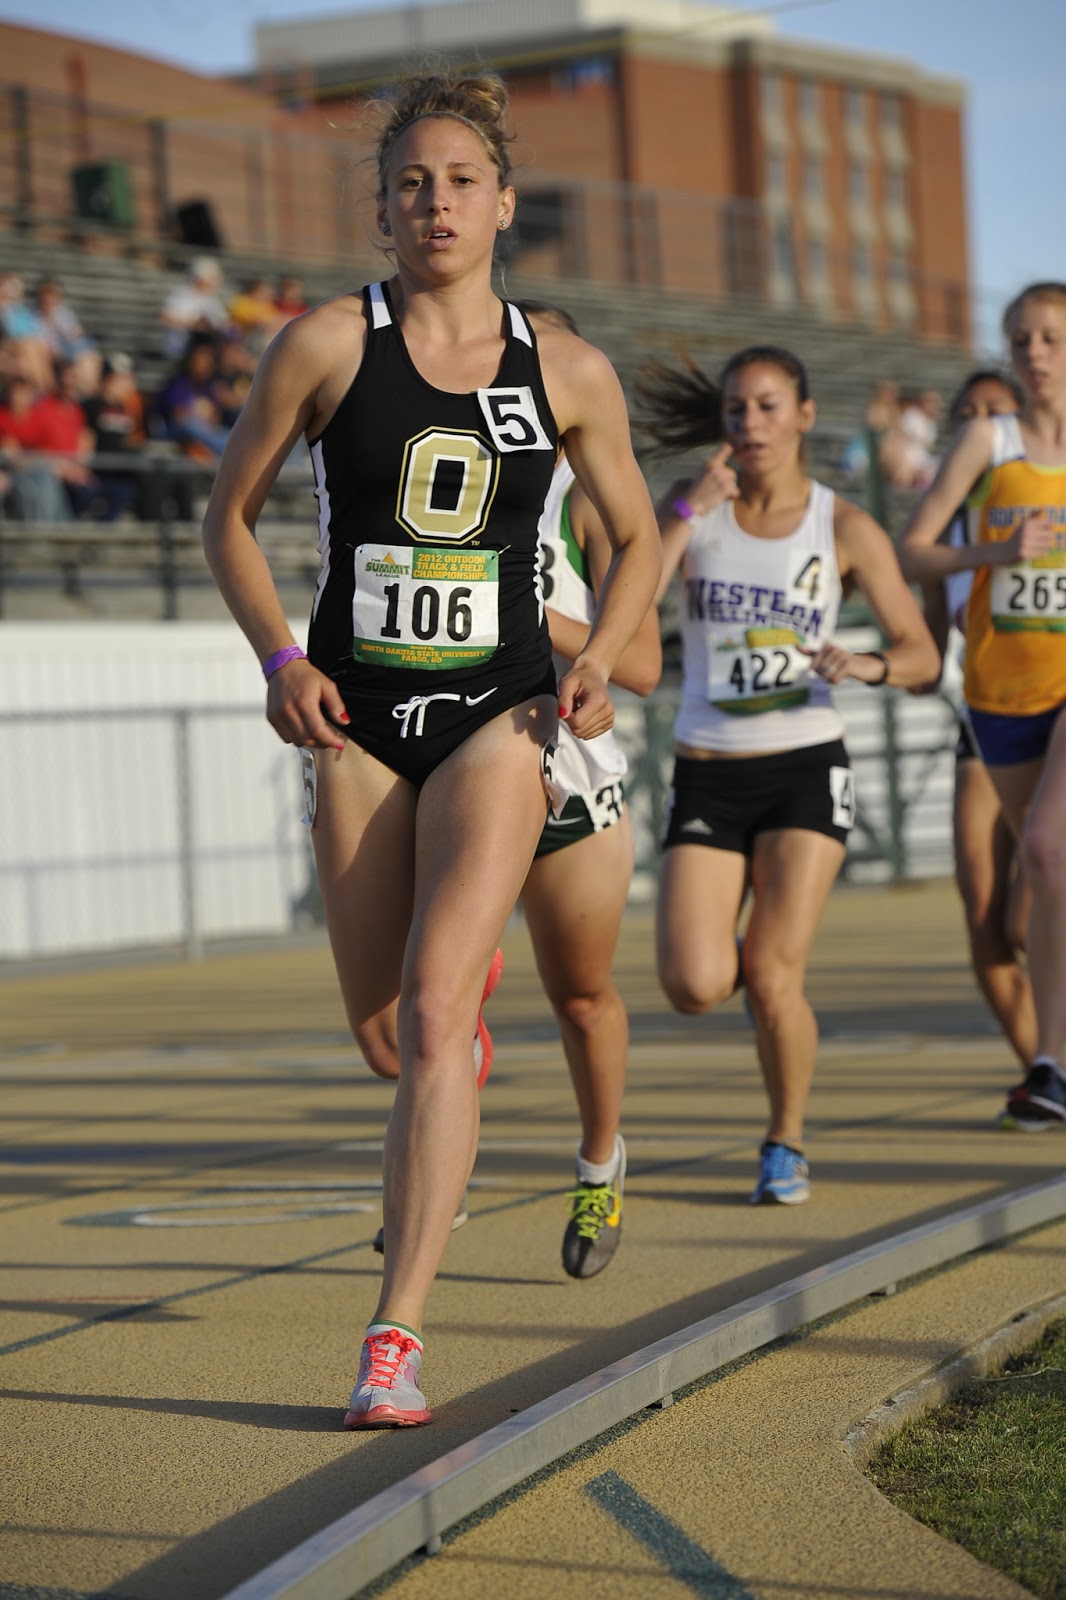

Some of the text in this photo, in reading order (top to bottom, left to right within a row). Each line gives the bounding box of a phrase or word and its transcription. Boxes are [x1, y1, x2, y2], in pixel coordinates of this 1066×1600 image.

[487, 395, 537, 446] 5
[418, 553, 486, 564] 2012 OUTDOOR
[365, 562, 411, 575] SUMMIT
[416, 562, 484, 572] TRACK & FIELD
[413, 569, 488, 580] CHAMPIONSHIPS
[794, 556, 821, 600] 4
[1009, 573, 1066, 611] 265
[380, 583, 472, 642] 106
[361, 644, 384, 653] NORTH
[386, 647, 415, 656] DAKOTA
[402, 655, 430, 663] FARGO,
[729, 651, 793, 694] 422
